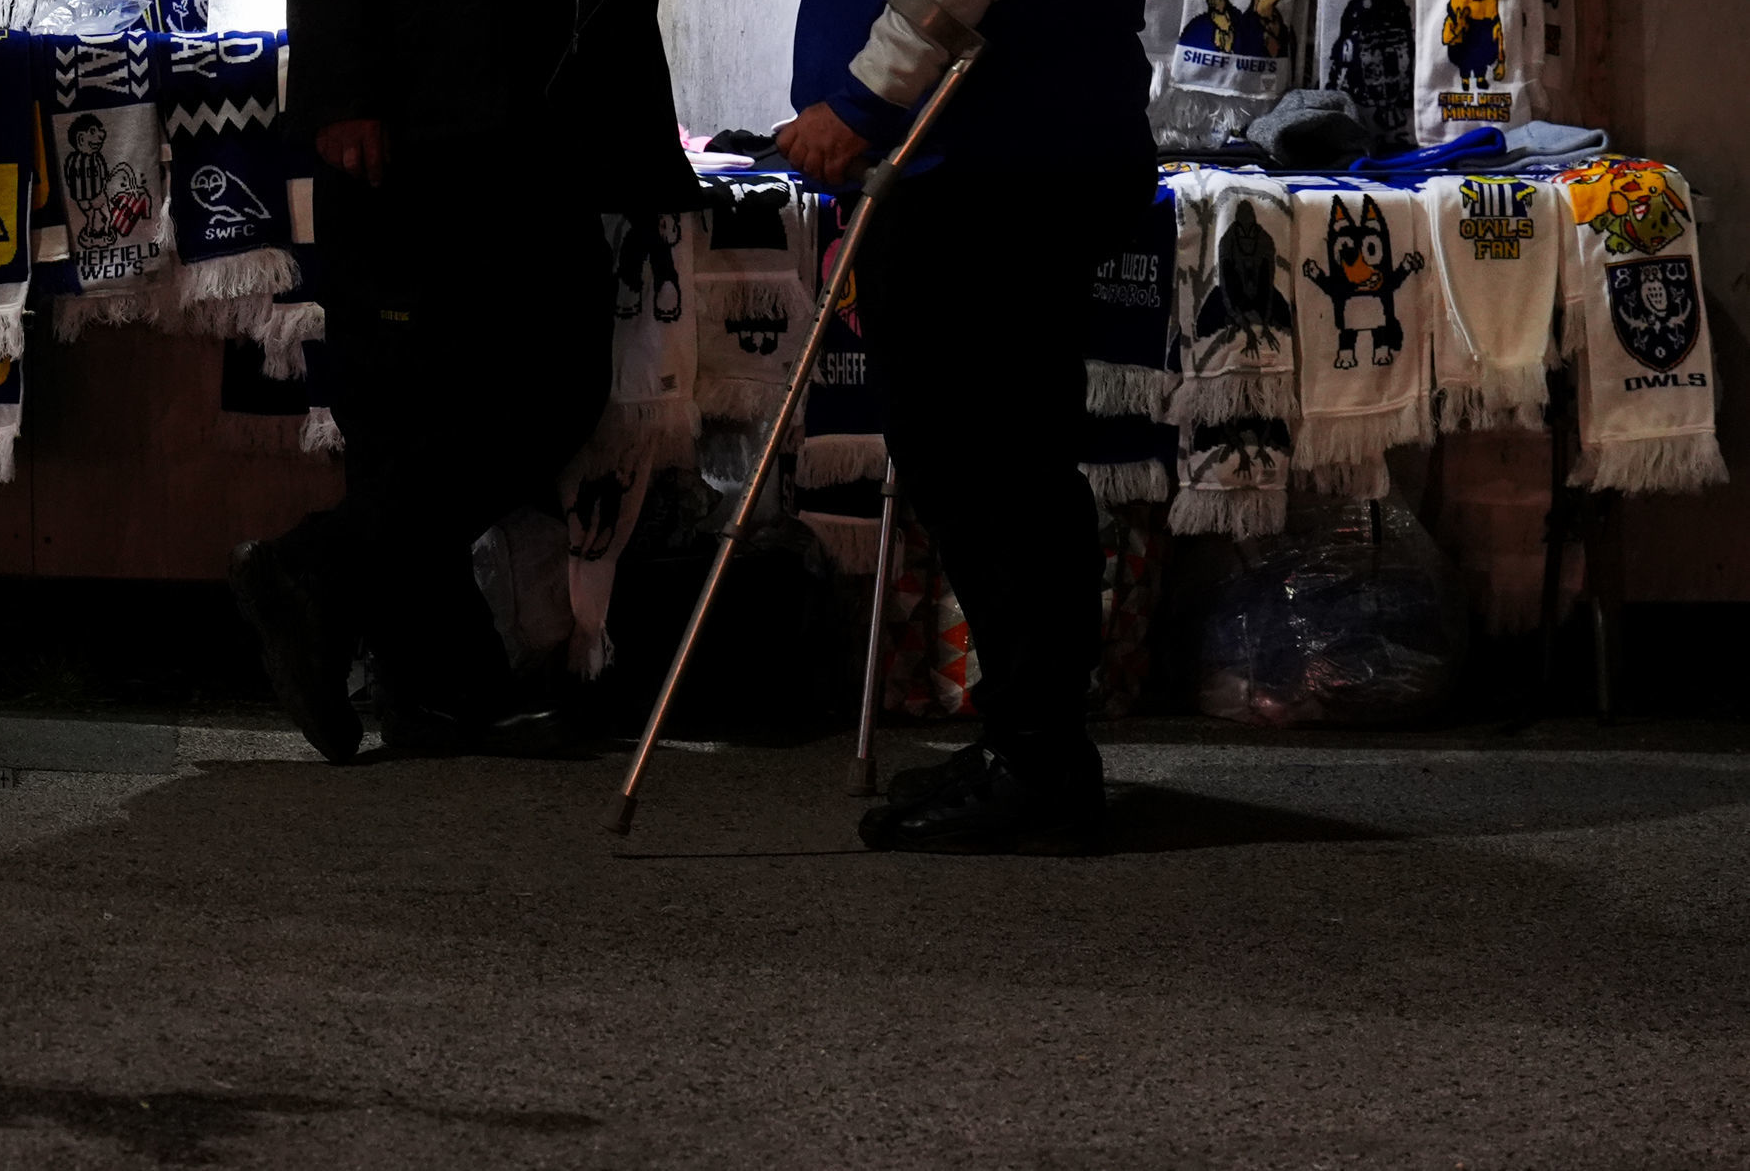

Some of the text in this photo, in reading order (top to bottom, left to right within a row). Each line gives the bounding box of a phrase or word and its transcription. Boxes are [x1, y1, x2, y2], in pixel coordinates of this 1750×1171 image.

[1183, 49, 1278, 74] SHEFF WED'S
[1439, 92, 1474, 106] SHEFF
[1442, 106, 1510, 123] MINIONS
[204, 224, 257, 242] SWFC
[1460, 218, 1534, 239] OWLS
[70, 243, 160, 267] HEFFIELD
[1475, 239, 1520, 260] FAN
[80, 260, 144, 280] WED'S
[826, 351, 867, 385] SHEFF
[1625, 373, 1708, 391] OWLS
